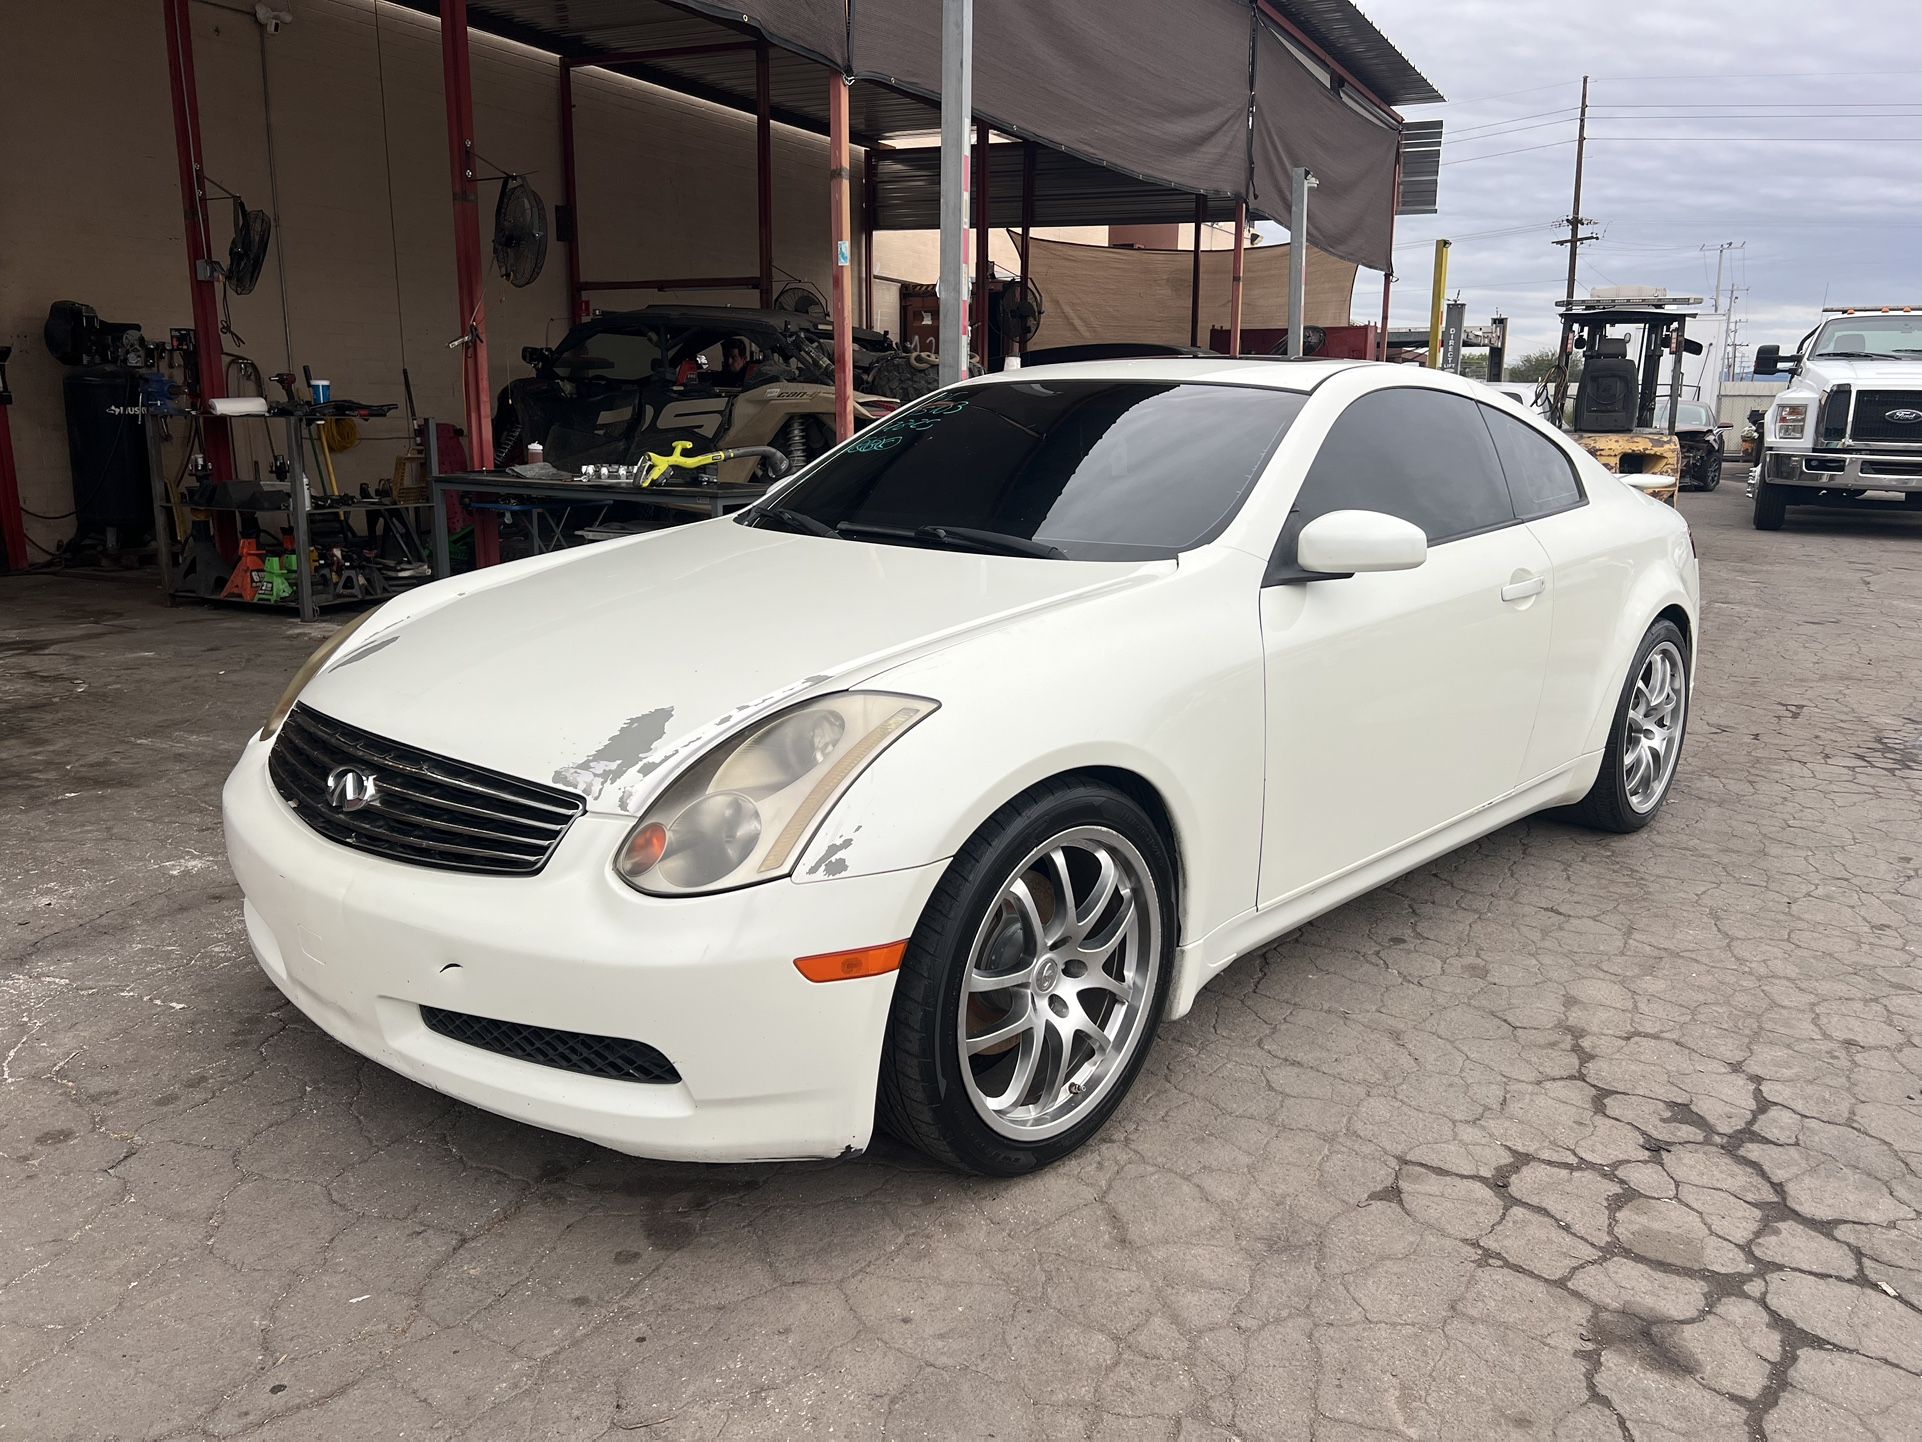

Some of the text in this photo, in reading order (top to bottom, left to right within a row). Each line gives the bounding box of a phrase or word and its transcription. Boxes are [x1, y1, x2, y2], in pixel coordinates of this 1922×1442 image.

[1447, 327, 1456, 364] DIRECT
[119, 406, 148, 415] HUS
[1893, 411, 1916, 420] Ford
